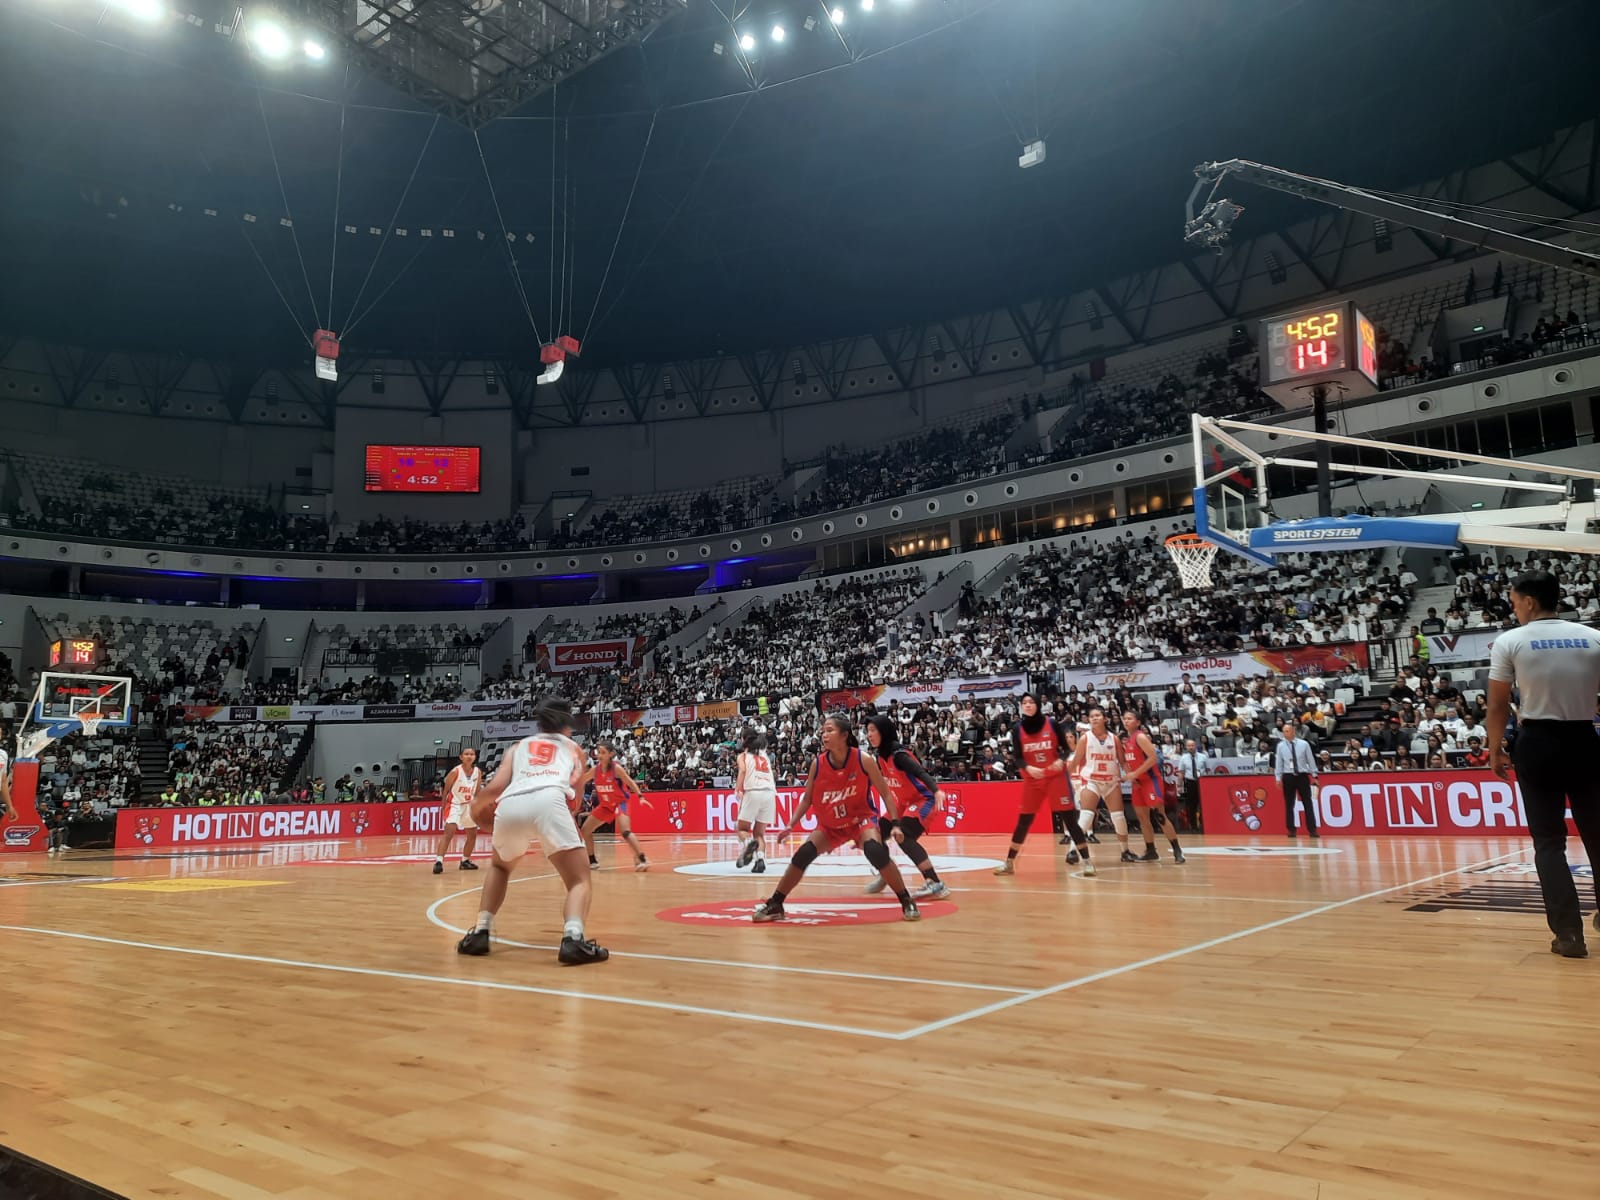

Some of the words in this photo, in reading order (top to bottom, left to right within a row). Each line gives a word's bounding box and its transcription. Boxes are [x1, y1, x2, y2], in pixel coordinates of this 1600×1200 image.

[1287, 313, 1338, 340] 4:52
[1298, 340, 1327, 369] 14
[407, 475, 438, 485] 4:52
[1530, 639, 1590, 650] REFEREE
[76, 651, 89, 662] 14
[573, 650, 625, 661] HONDA
[528, 741, 556, 766] 9
[753, 755, 769, 773] 12
[832, 804, 847, 819] 13
[1383, 782, 1438, 828] IN
[172, 813, 227, 841] HOT
[227, 812, 255, 839] IN
[258, 810, 340, 837] CREAM
[409, 806, 439, 832] HOT
